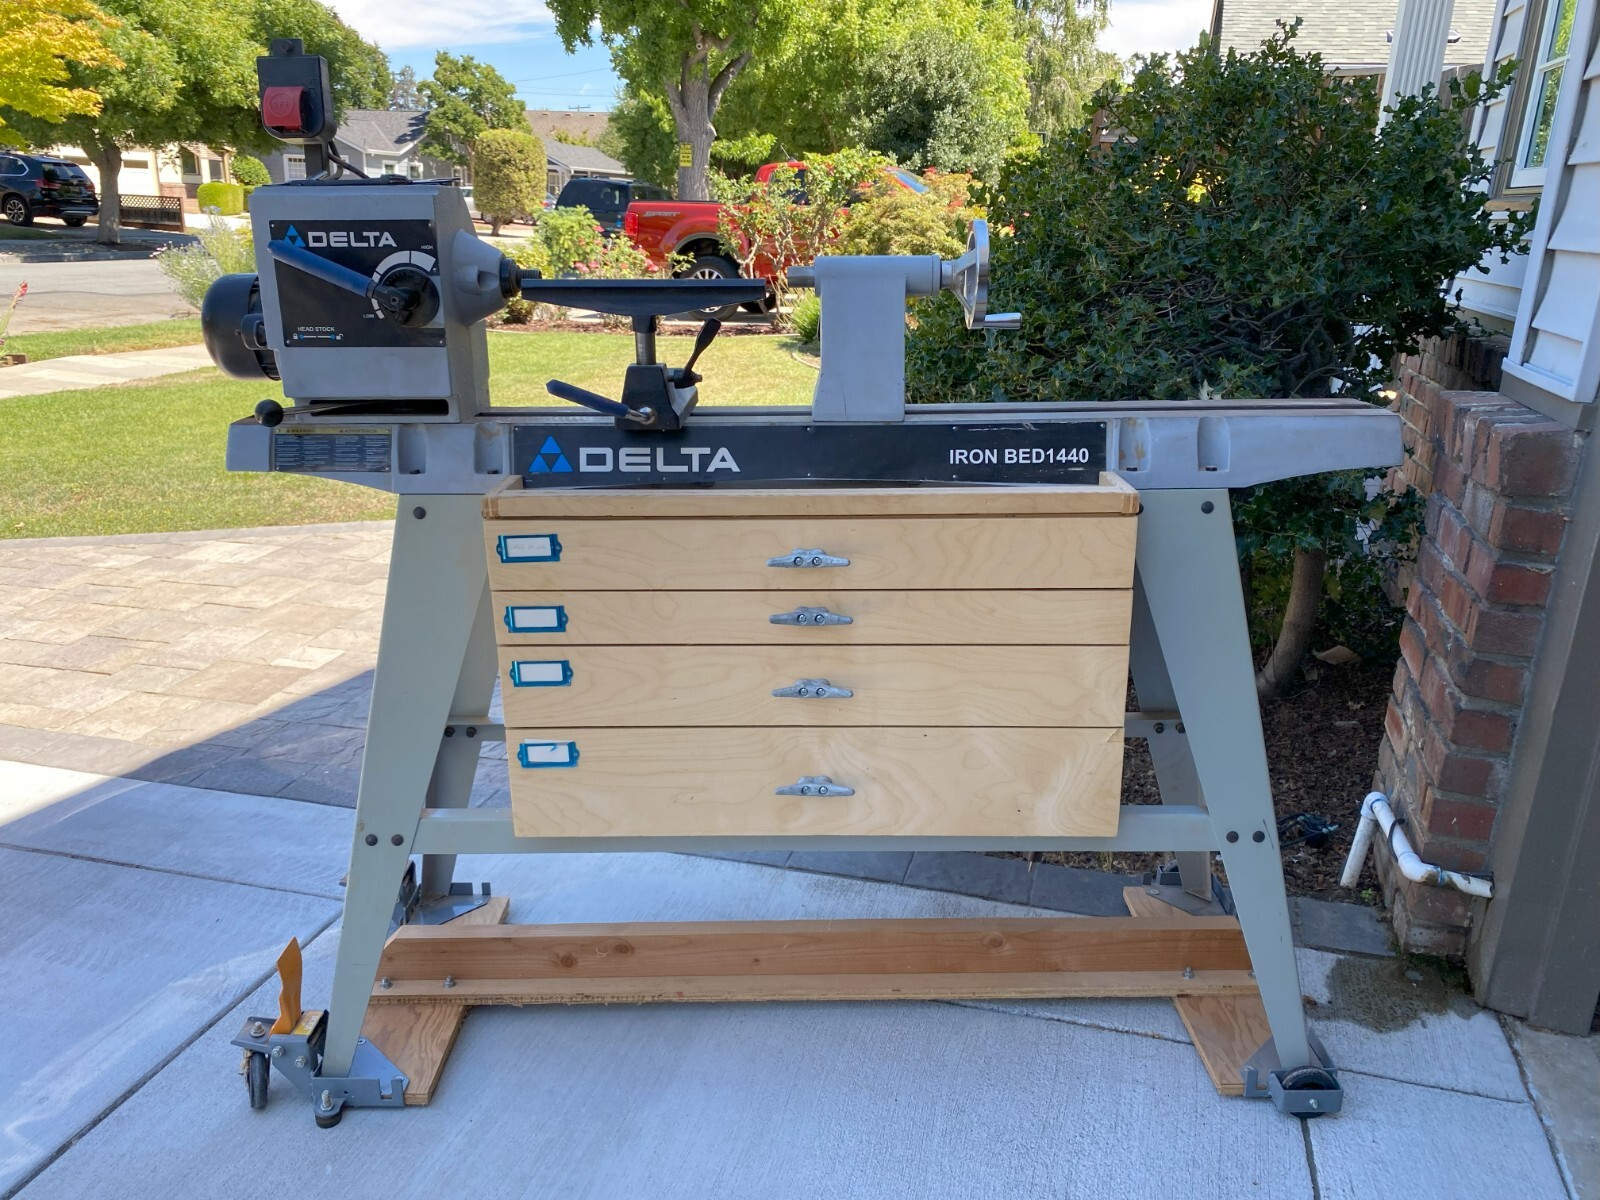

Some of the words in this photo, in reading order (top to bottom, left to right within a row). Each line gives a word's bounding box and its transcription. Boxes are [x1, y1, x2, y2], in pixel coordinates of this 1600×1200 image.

[643, 210, 681, 218] SPORT
[307, 231, 398, 248] DELTA
[579, 447, 741, 473] DELTA
[949, 448, 998, 465] IRON
[1004, 447, 1089, 464] BED1440
